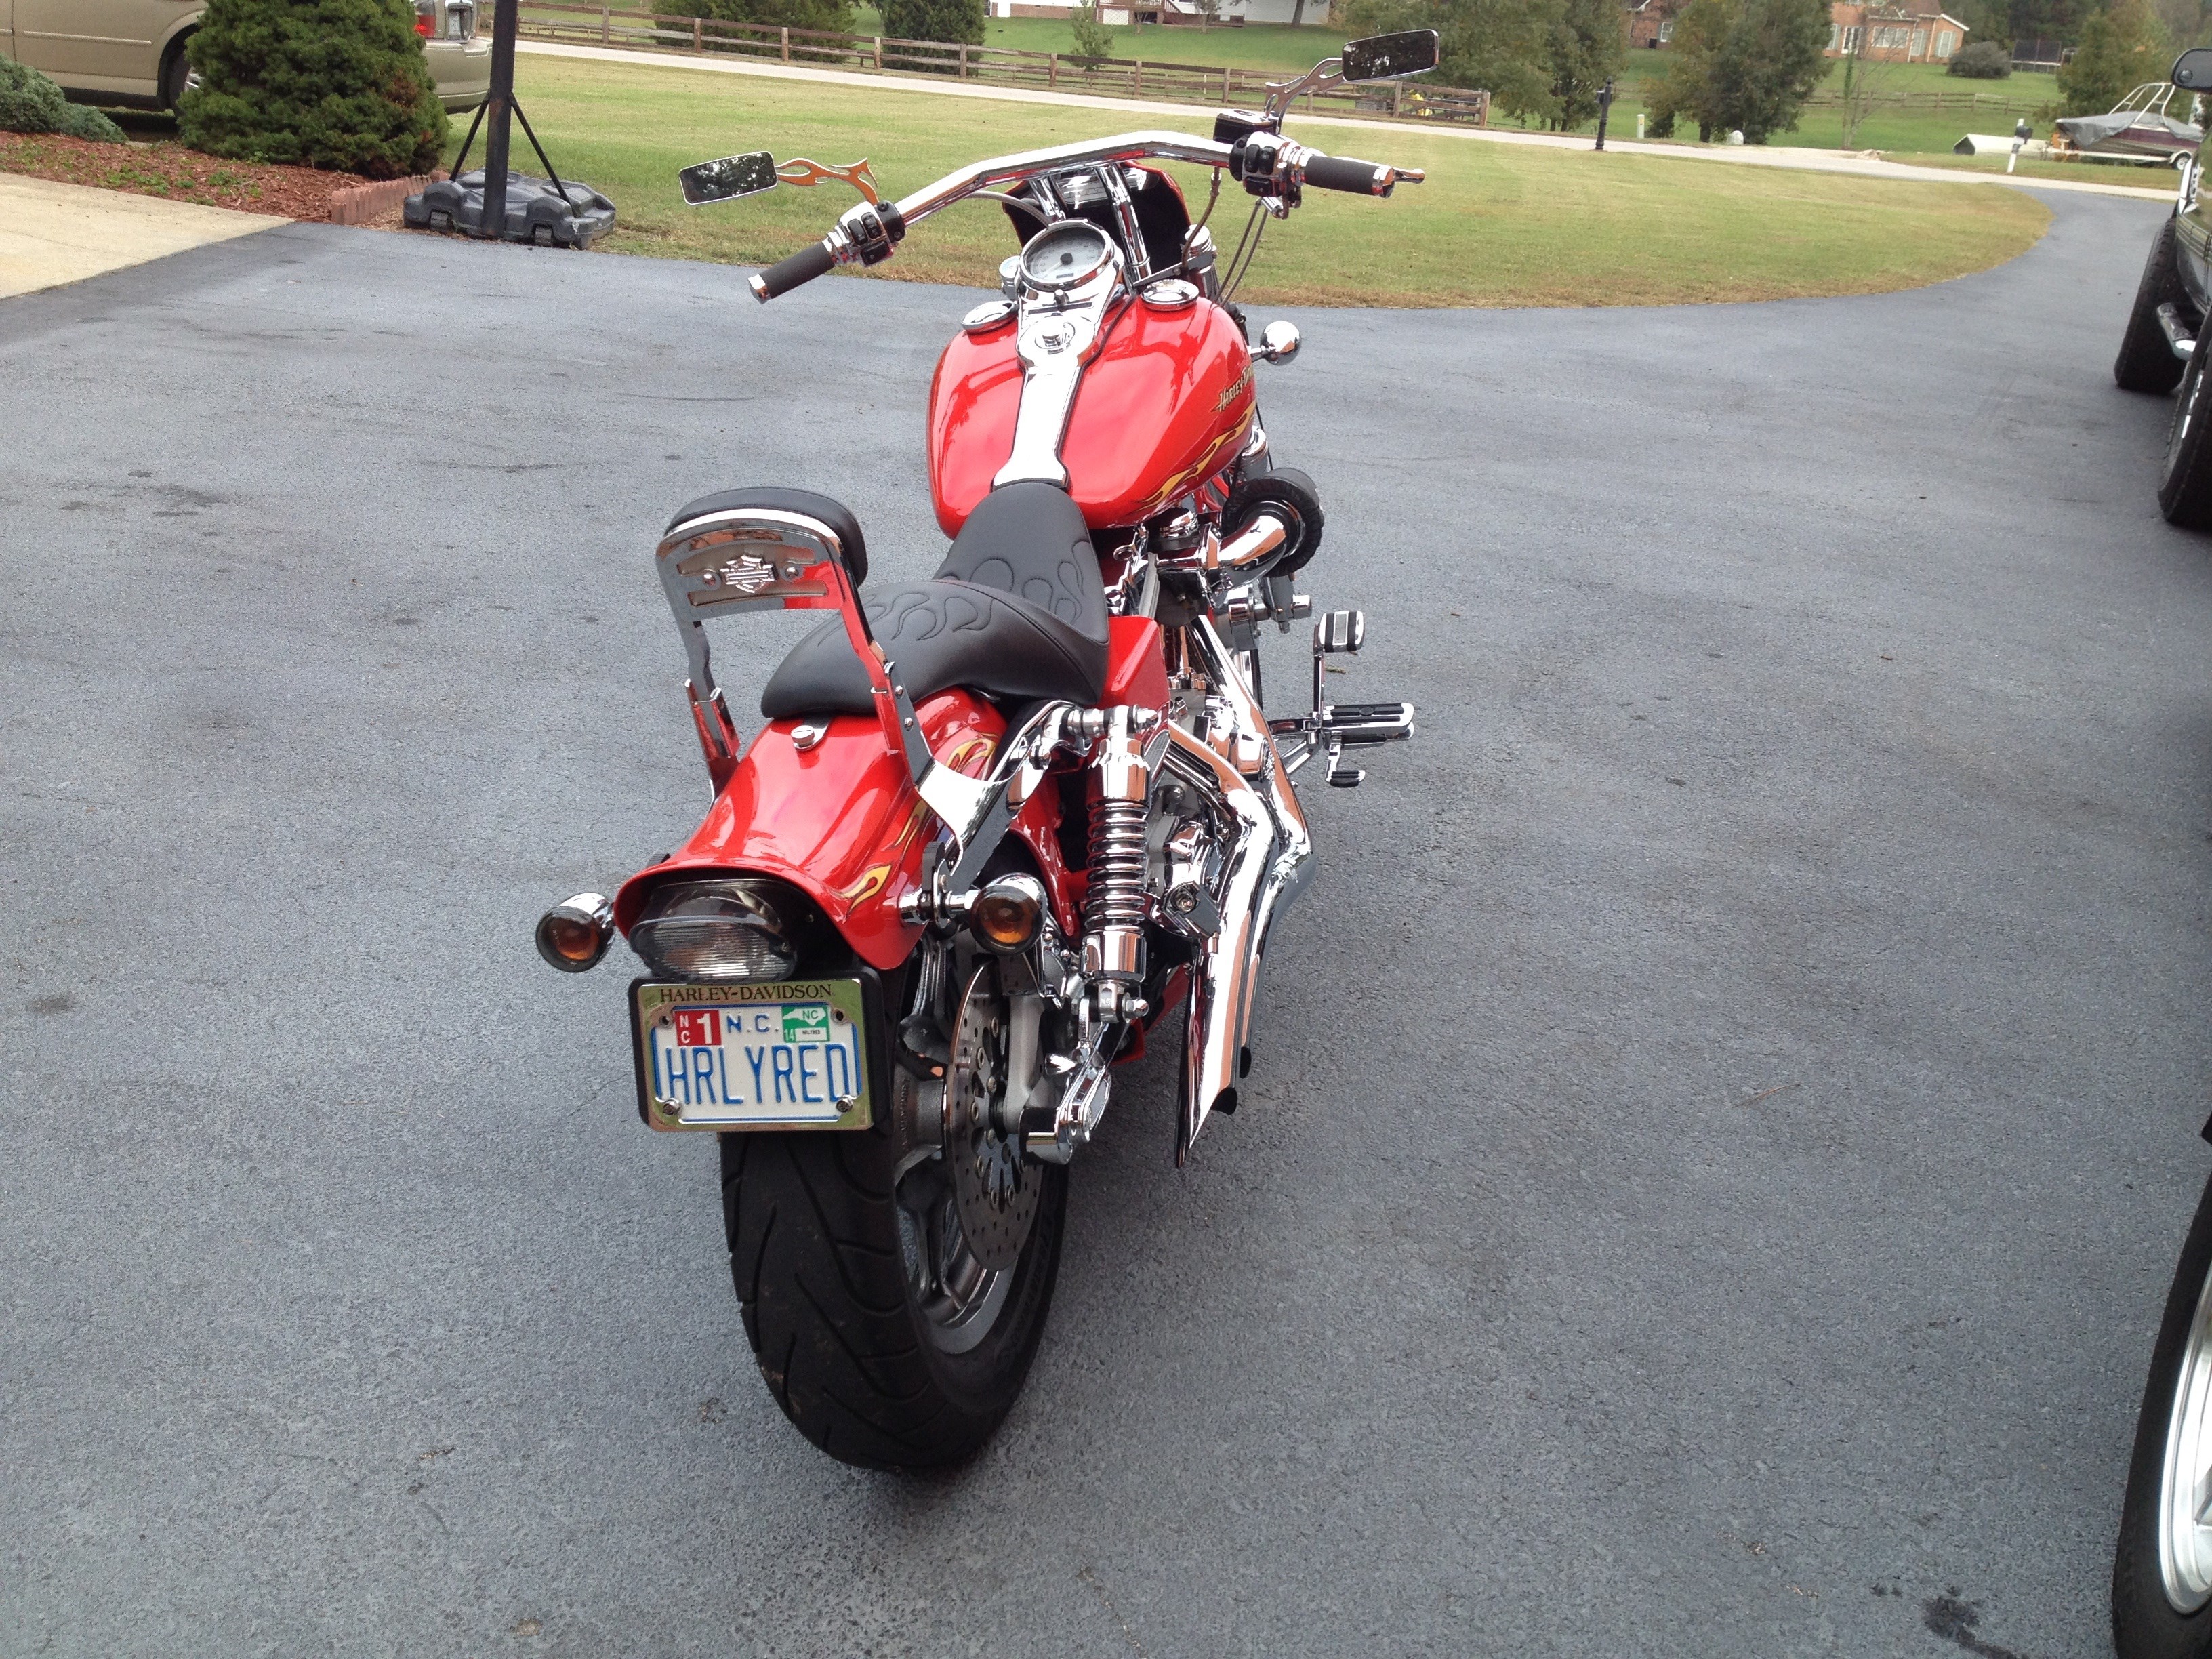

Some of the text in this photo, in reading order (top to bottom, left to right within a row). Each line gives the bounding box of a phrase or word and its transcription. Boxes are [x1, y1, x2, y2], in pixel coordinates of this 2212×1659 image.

[659, 983, 832, 1002] HARLEY-DAVIDSON
[802, 1009, 819, 1021] NC
[697, 1012, 713, 1045] 1
[783, 1028, 795, 1042] 14
[665, 1044, 851, 1105] HRLYRED
